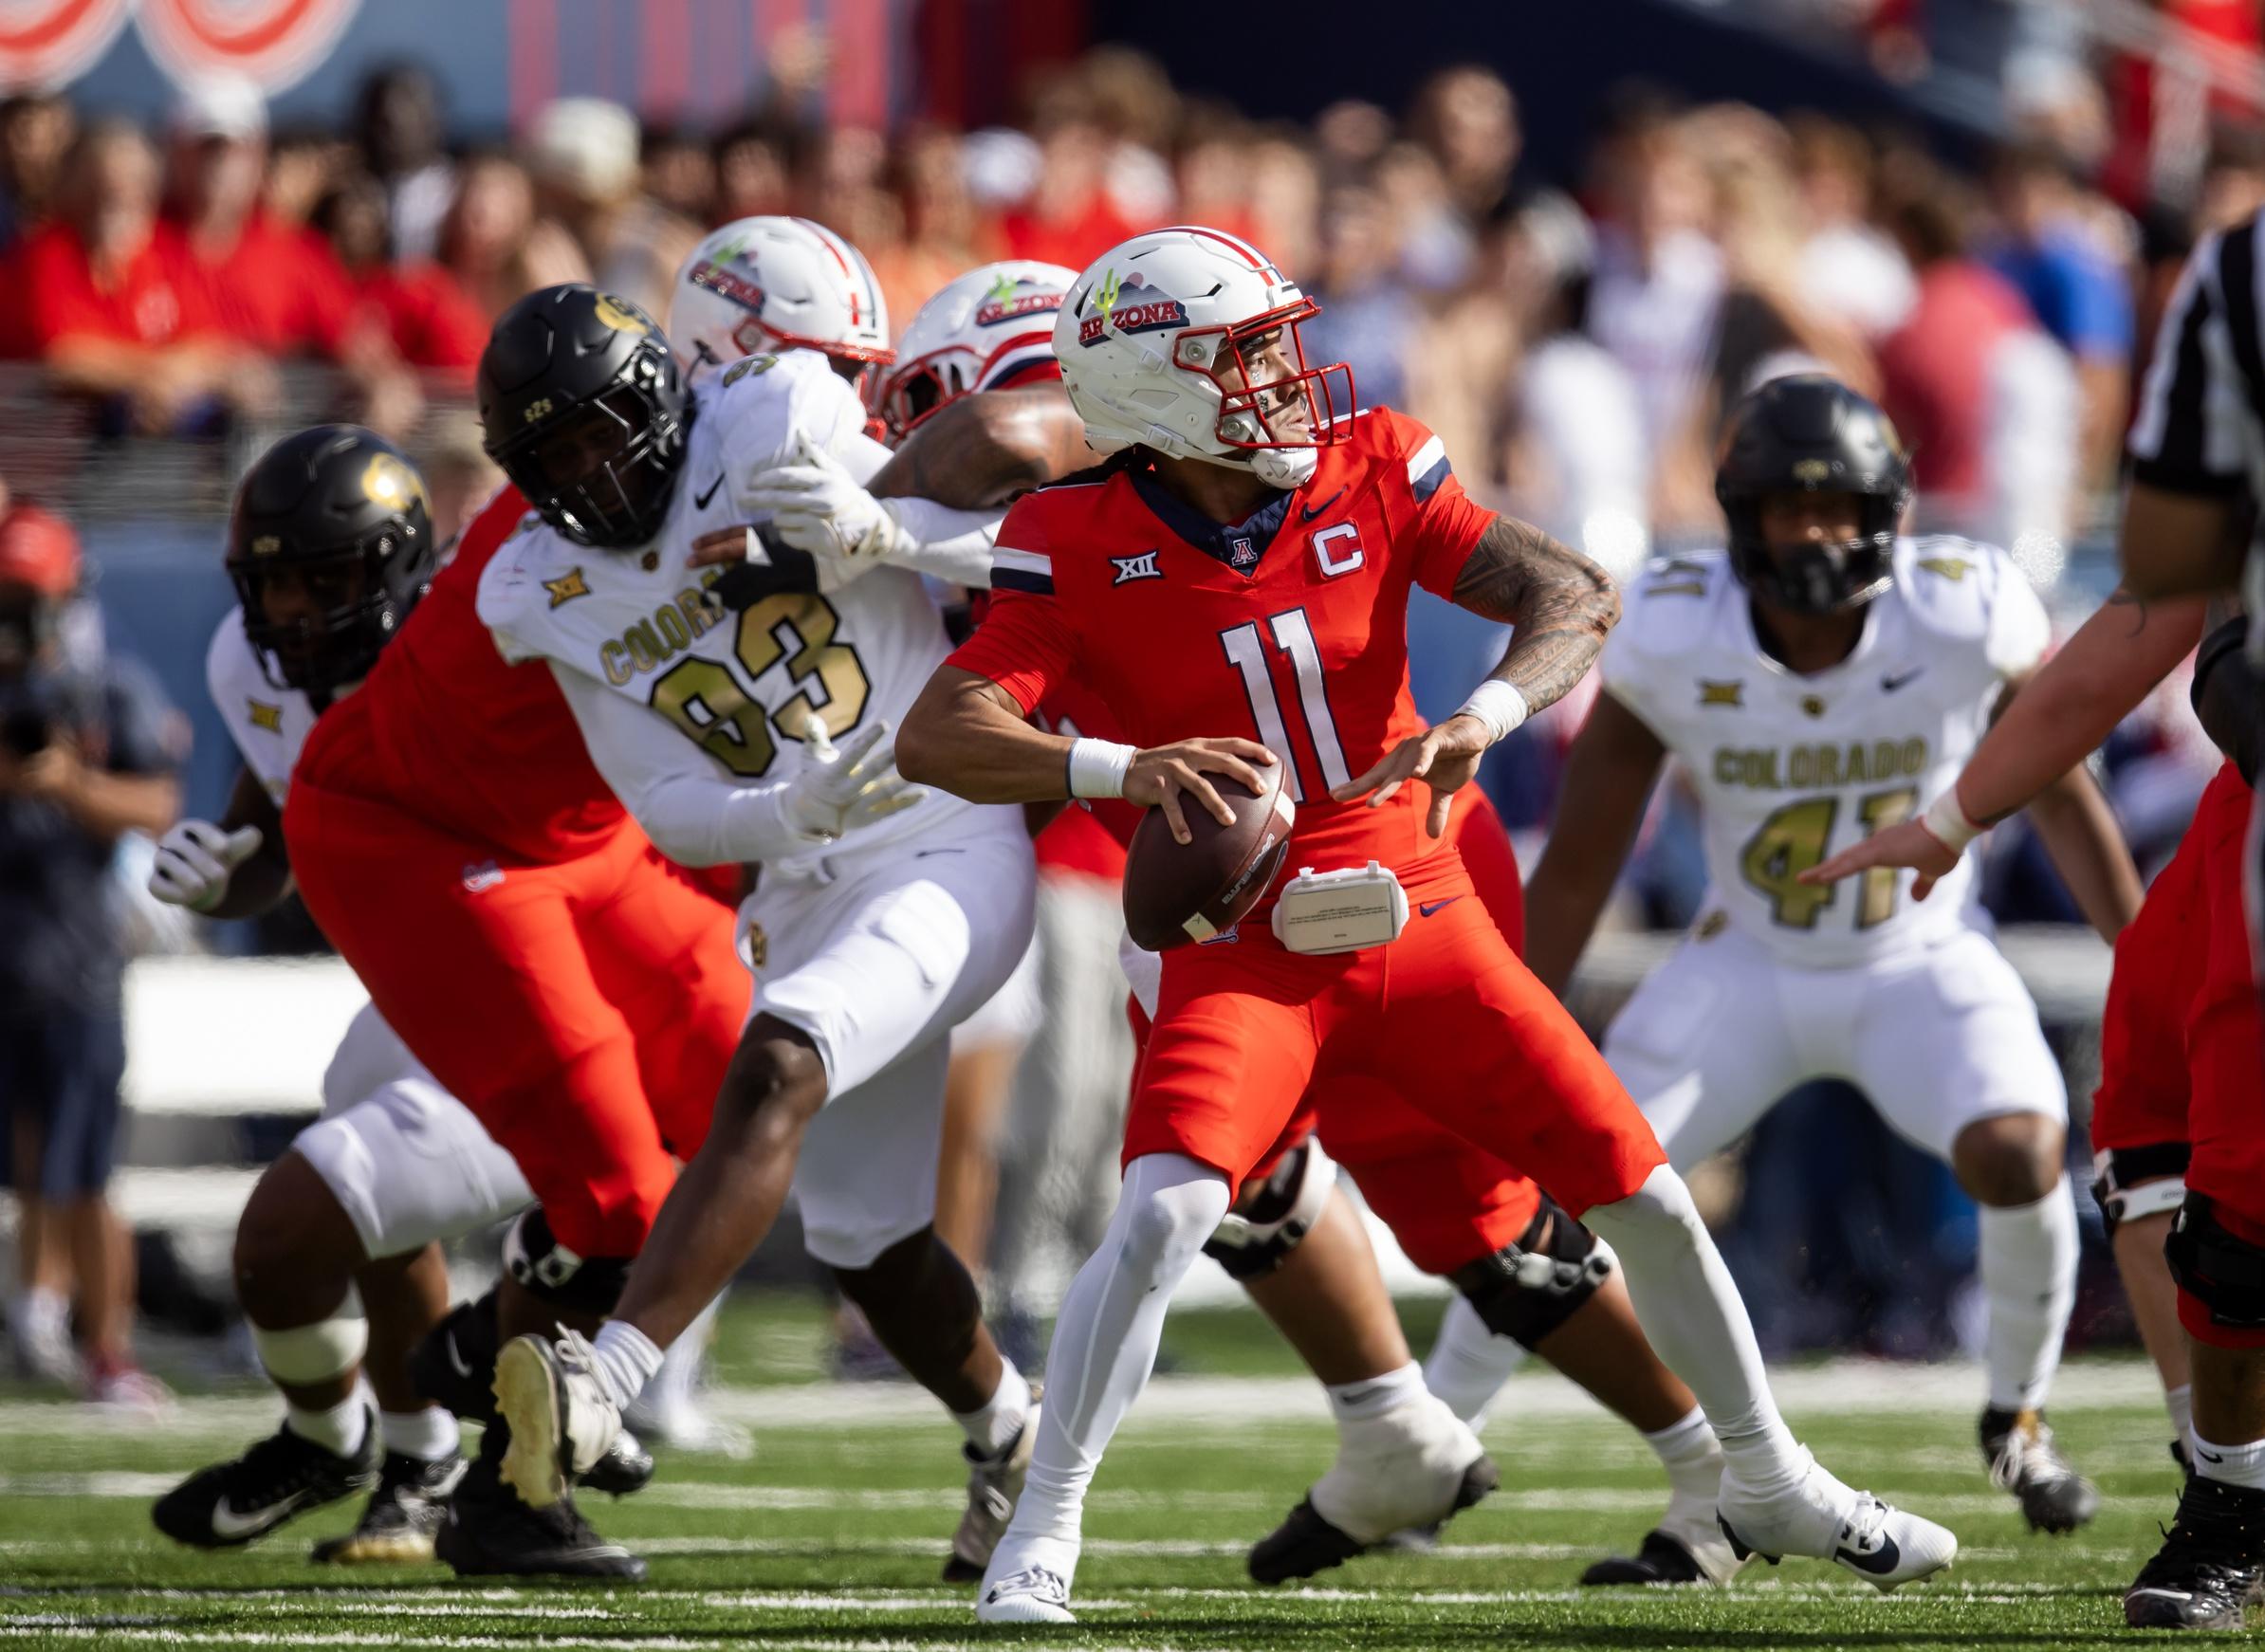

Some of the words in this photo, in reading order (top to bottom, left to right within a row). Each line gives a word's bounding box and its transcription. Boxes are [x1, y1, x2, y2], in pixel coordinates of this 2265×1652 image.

[1110, 549, 1163, 585] XII
[1232, 537, 1259, 566] A
[1311, 521, 1366, 578] C
[649, 592, 872, 778] 93
[1218, 605, 1353, 803] 11
[1714, 735, 1927, 789] COLORADO
[1740, 783, 1921, 930] 41
